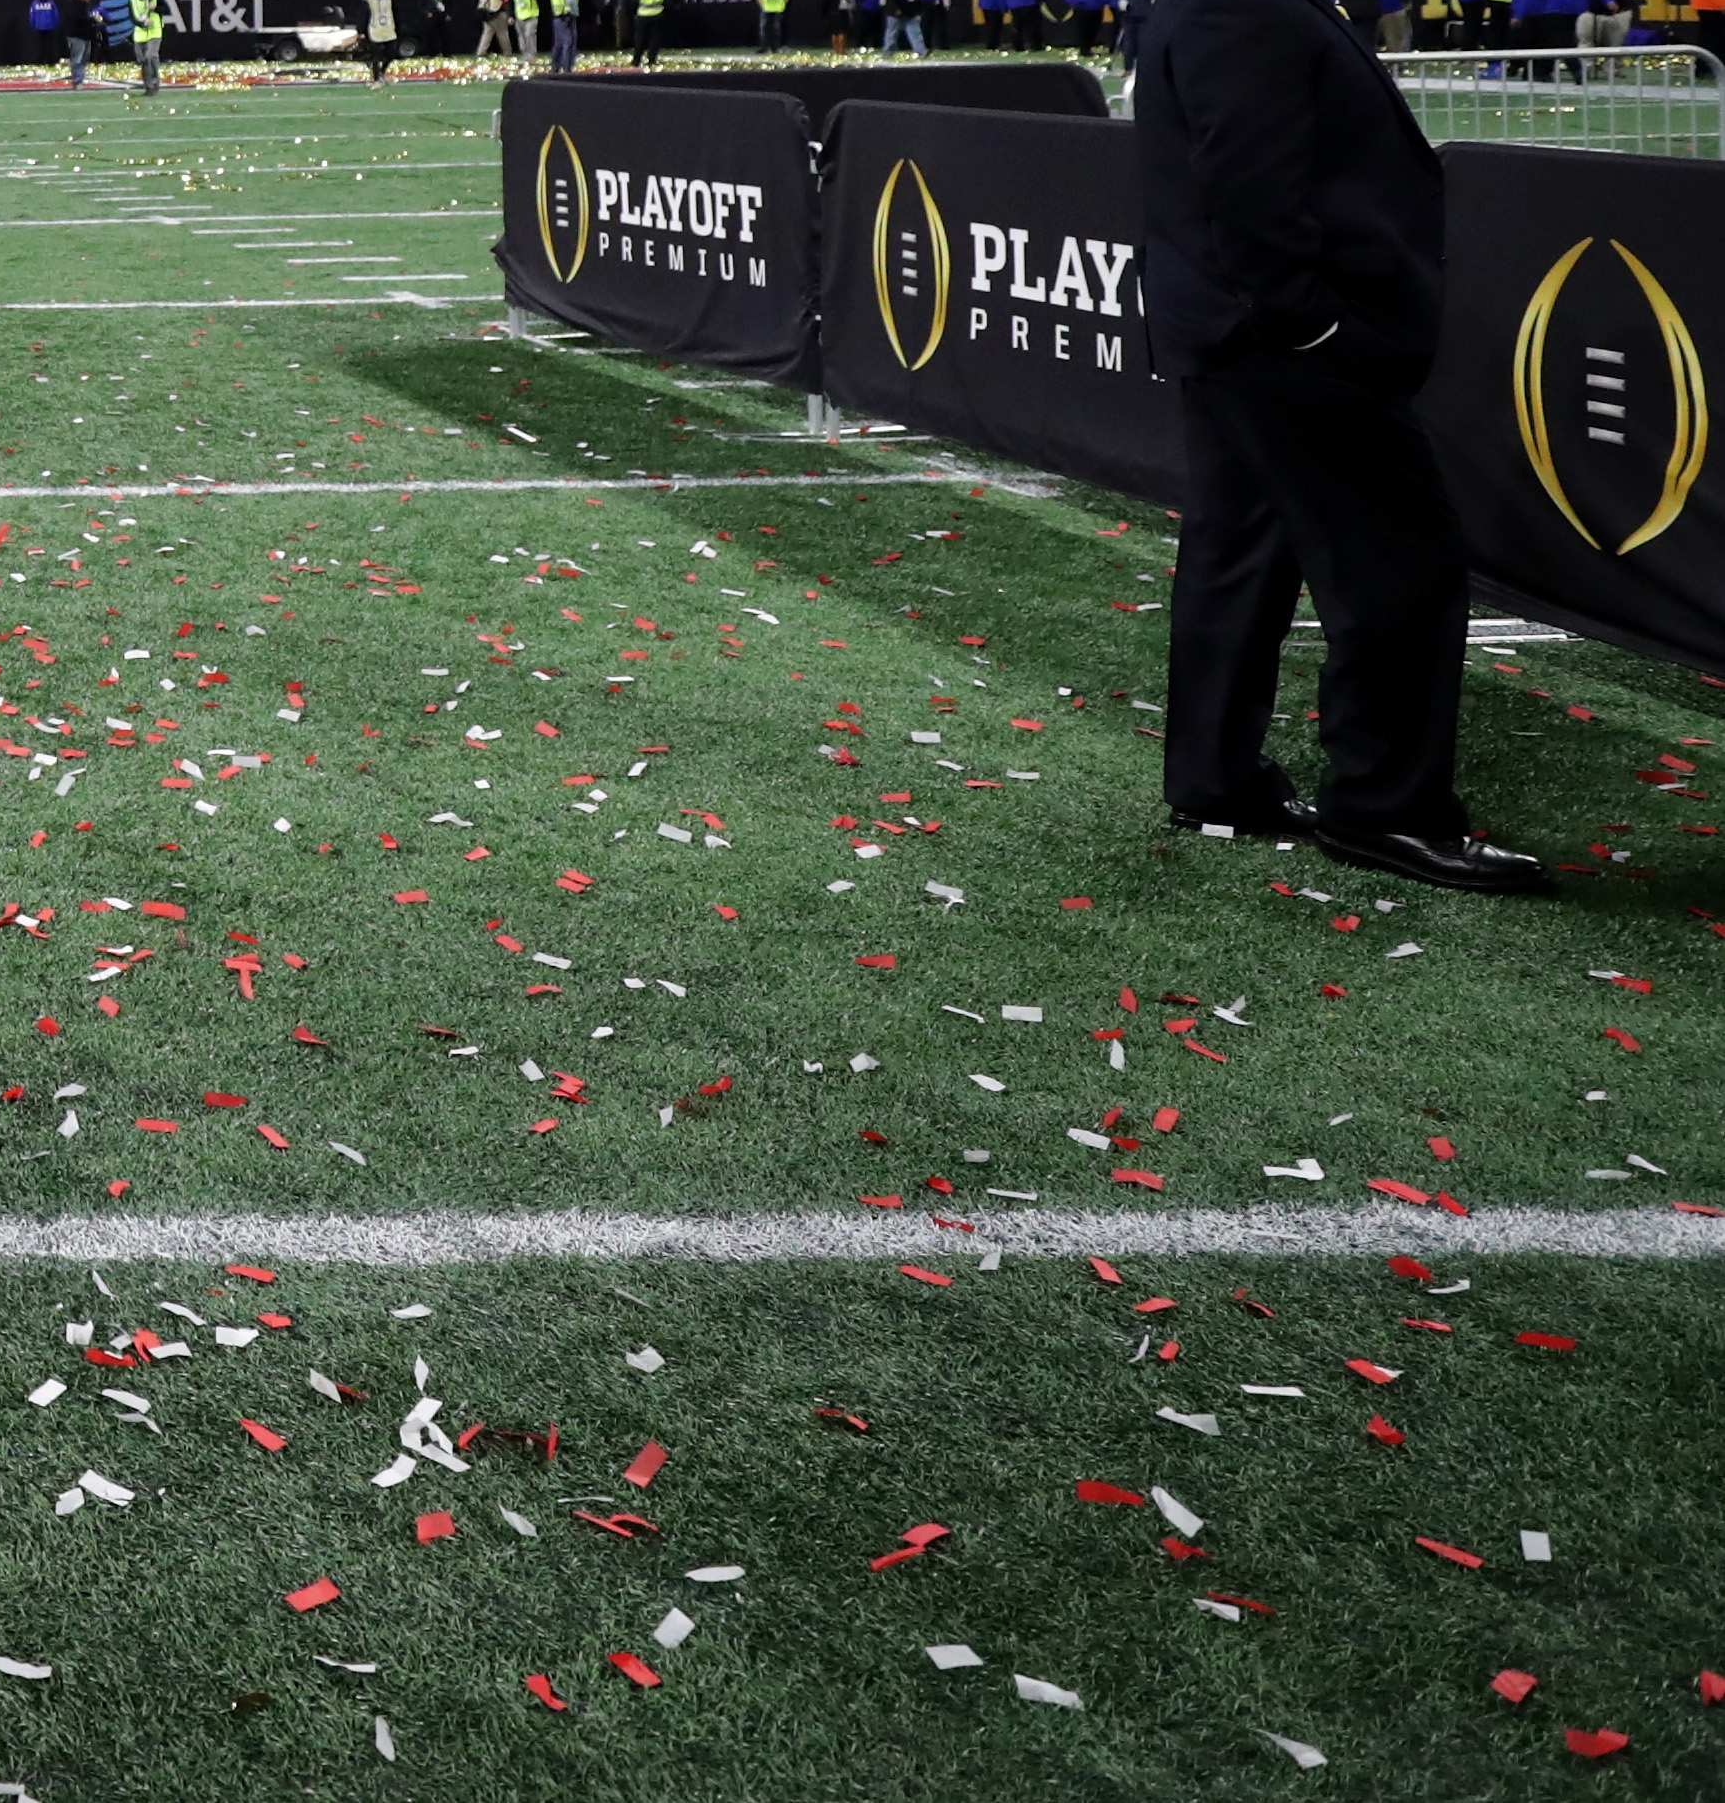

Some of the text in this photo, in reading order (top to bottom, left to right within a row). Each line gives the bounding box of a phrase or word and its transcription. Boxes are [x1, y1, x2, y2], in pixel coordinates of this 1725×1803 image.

[596, 168, 763, 244] PLAYOFF
[598, 232, 768, 288] PREMIUM
[970, 222, 1146, 320] PLAY
[970, 307, 1126, 376] PREM
